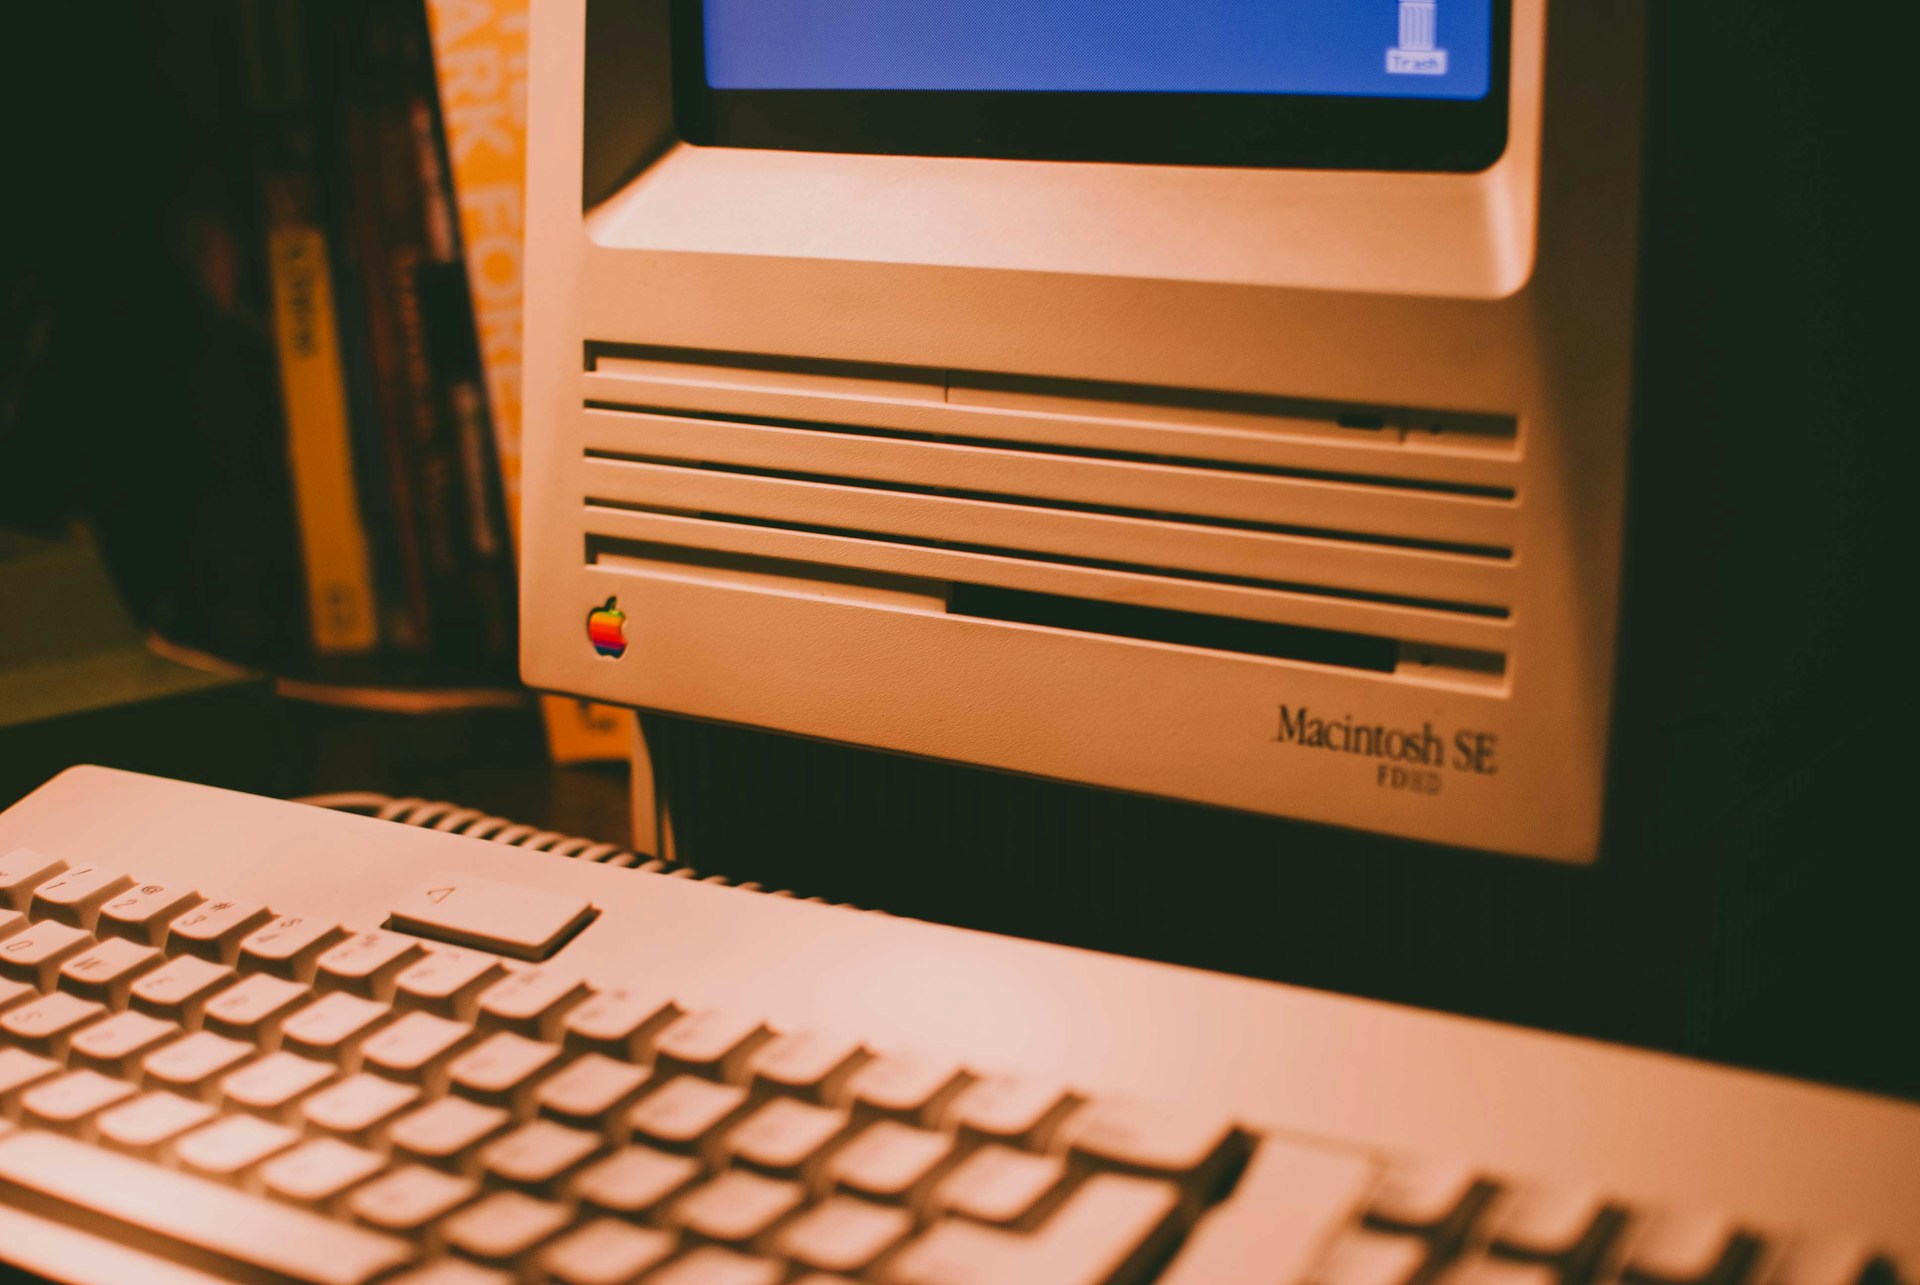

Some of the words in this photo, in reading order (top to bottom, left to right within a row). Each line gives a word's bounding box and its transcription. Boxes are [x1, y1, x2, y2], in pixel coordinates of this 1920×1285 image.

[1392, 55, 1439, 72] Trash
[1273, 703, 1446, 769] Macintosh
[1453, 728, 1499, 776] SE
